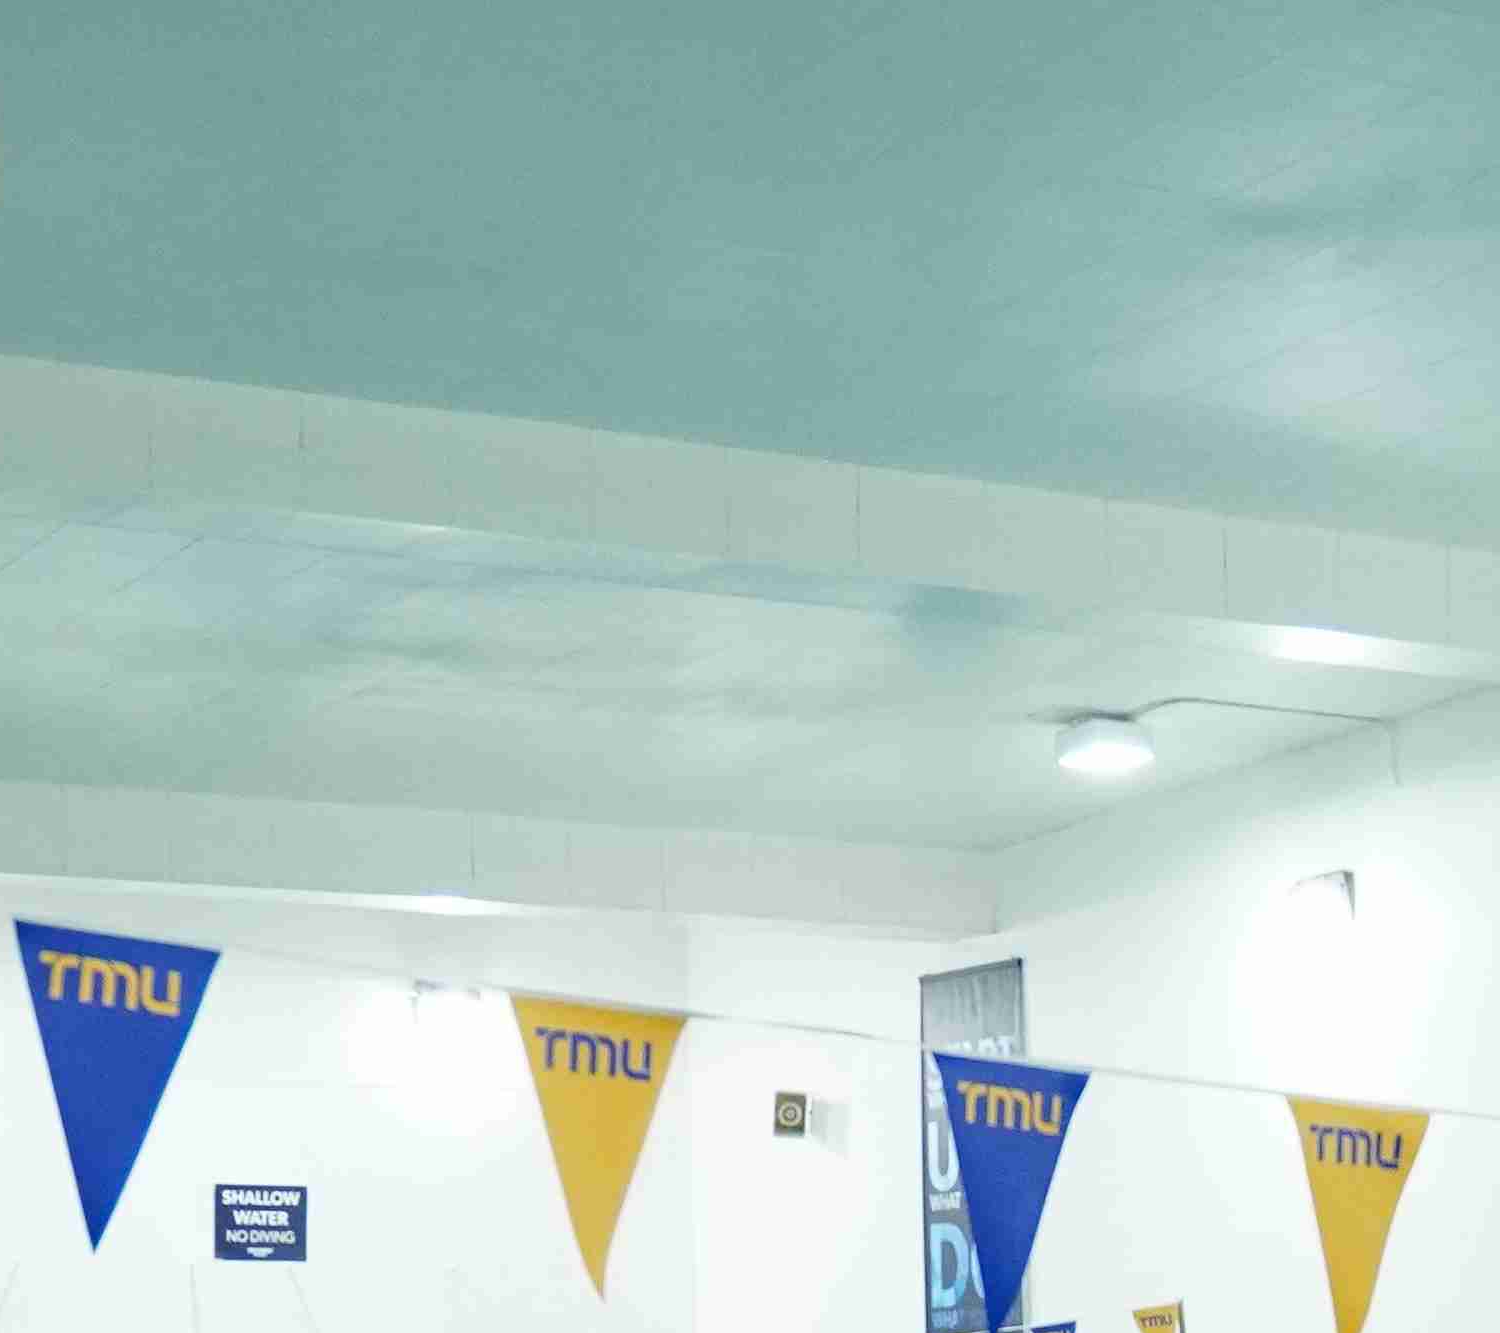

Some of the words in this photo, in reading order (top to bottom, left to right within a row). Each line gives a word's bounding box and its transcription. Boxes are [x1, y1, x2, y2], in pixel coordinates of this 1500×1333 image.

[40, 949, 182, 1018] TMU
[534, 1026, 653, 1081] TMU
[956, 1081, 1063, 1136] TMU
[1309, 1123, 1402, 1169] TMU
[221, 1189, 301, 1206] SHALLOW
[233, 1209, 289, 1226] WATER
[225, 1229, 248, 1243] NO
[250, 1230, 296, 1244] DIVING
